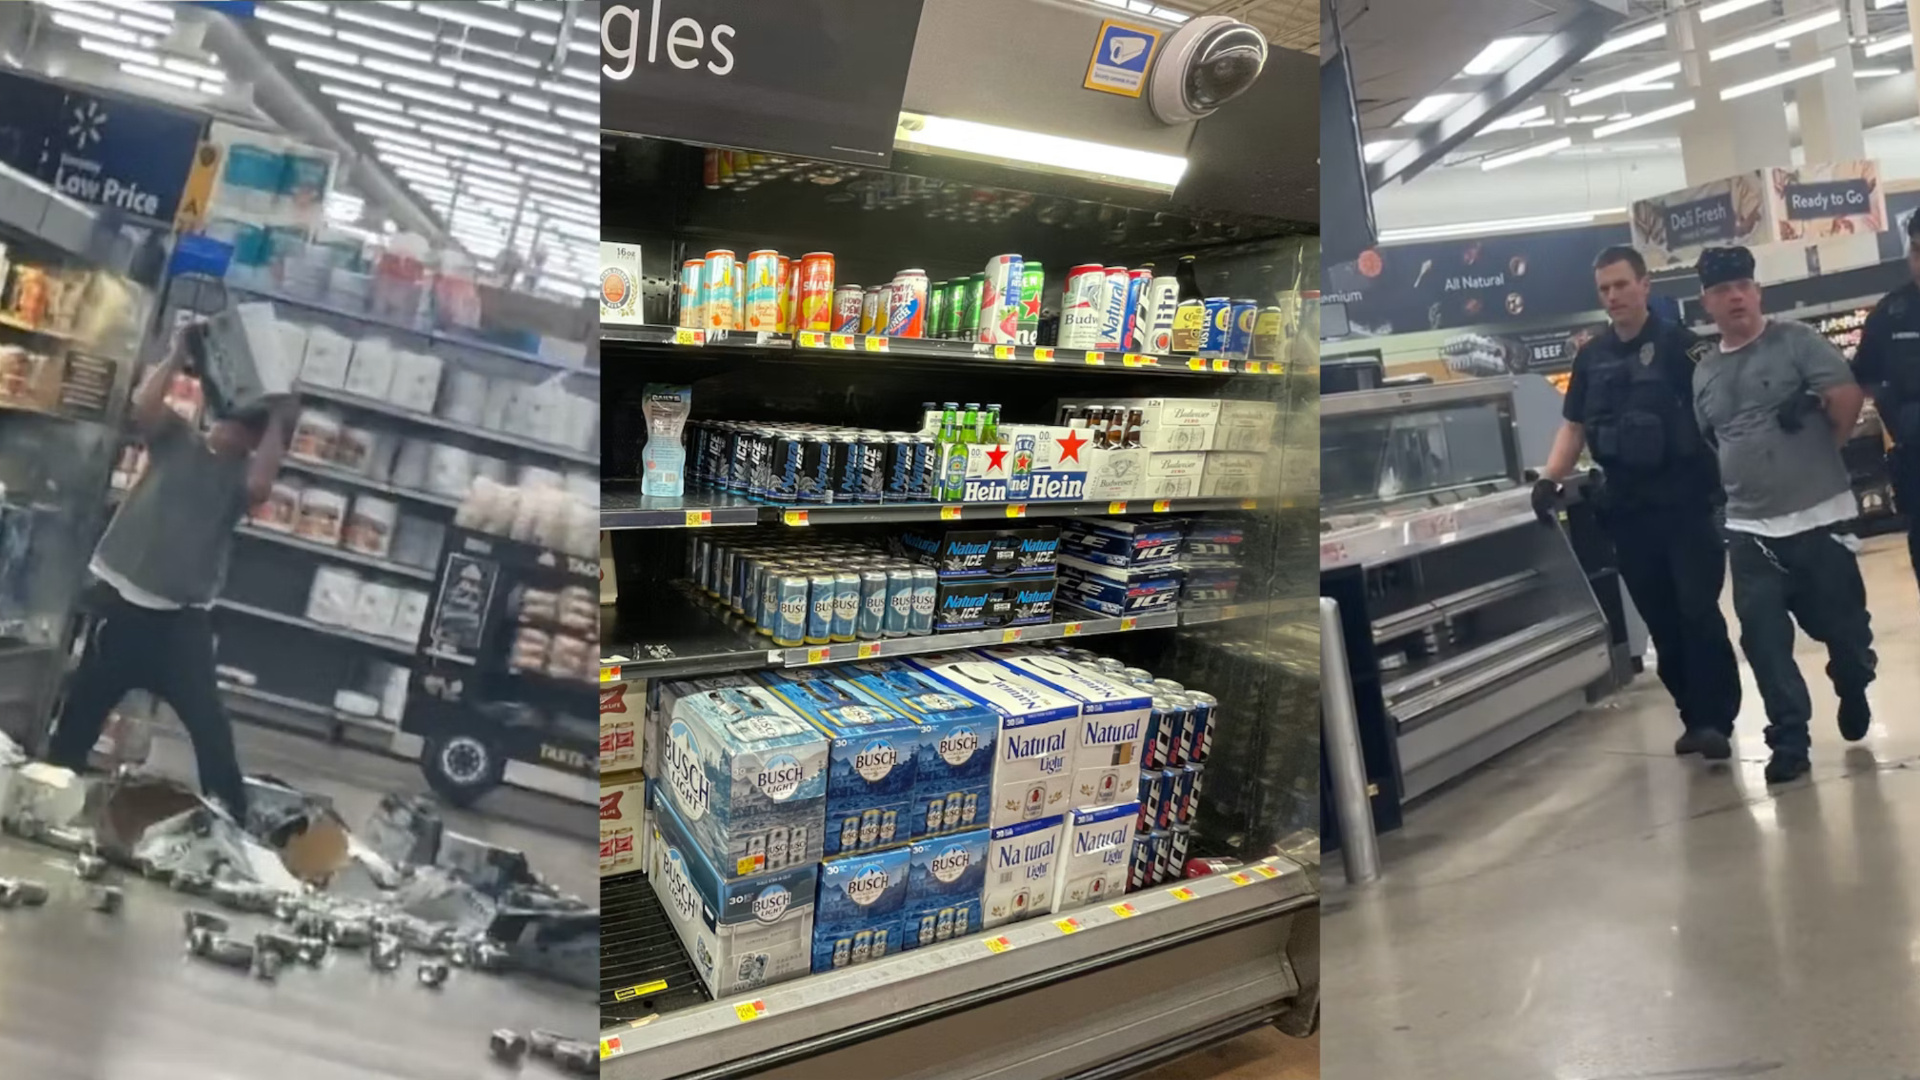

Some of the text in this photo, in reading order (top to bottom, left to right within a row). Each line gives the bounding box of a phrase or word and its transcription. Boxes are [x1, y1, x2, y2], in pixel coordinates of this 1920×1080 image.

[55, 166, 159, 216] Low Price
[1792, 190, 1864, 212] Ready to Go
[1670, 203, 1727, 231] Deli Fresh
[1445, 274, 1505, 291] All Natural
[1101, 279, 1126, 342] Natural
[1533, 344, 1562, 360] BEEF
[735, 436, 749, 461] ICE
[751, 438, 762, 465] ICE
[863, 445, 877, 472] ICE
[924, 446, 935, 470] ICE
[946, 540, 992, 555] Natural
[1019, 537, 1060, 552] Natural
[1136, 543, 1178, 560] ICE
[962, 554, 986, 567] ICE
[1033, 551, 1054, 563] ICE
[833, 596, 859, 610] BUSC
[866, 598, 886, 608] BUS
[891, 596, 911, 608] BUS
[911, 593, 935, 605] BUSC
[943, 593, 989, 609] Natural
[1016, 588, 1056, 604] Natural
[1131, 592, 1175, 608] ICE
[780, 601, 806, 614] BUSC
[815, 600, 834, 613] BUS
[960, 606, 983, 619] ICE
[1029, 601, 1050, 614] ICE
[920, 725, 932, 733] 30
[1084, 717, 1141, 745] Natural
[834, 739, 848, 748] 30
[939, 737, 978, 754] BUSCH
[1007, 727, 1067, 760] Natural
[855, 751, 898, 769] BUSCH
[1040, 757, 1065, 775] Light
[664, 731, 710, 812] BUSCH
[757, 766, 804, 788] BUSCH
[671, 770, 702, 812] LIGHT
[767, 782, 795, 794] LIGHT
[1076, 823, 1129, 854] Natural
[912, 845, 924, 854] 30
[1103, 849, 1125, 866] Light
[826, 865, 839, 875] 30
[932, 854, 970, 872] BUSCH
[1026, 862, 1050, 881] Light
[662, 856, 697, 919] BUSCH
[848, 875, 889, 894] BUSCH
[668, 884, 688, 916] LIGHT
[728, 894, 744, 905] 30
[753, 892, 791, 913] BUSCH
[761, 906, 783, 917] LIGHT
